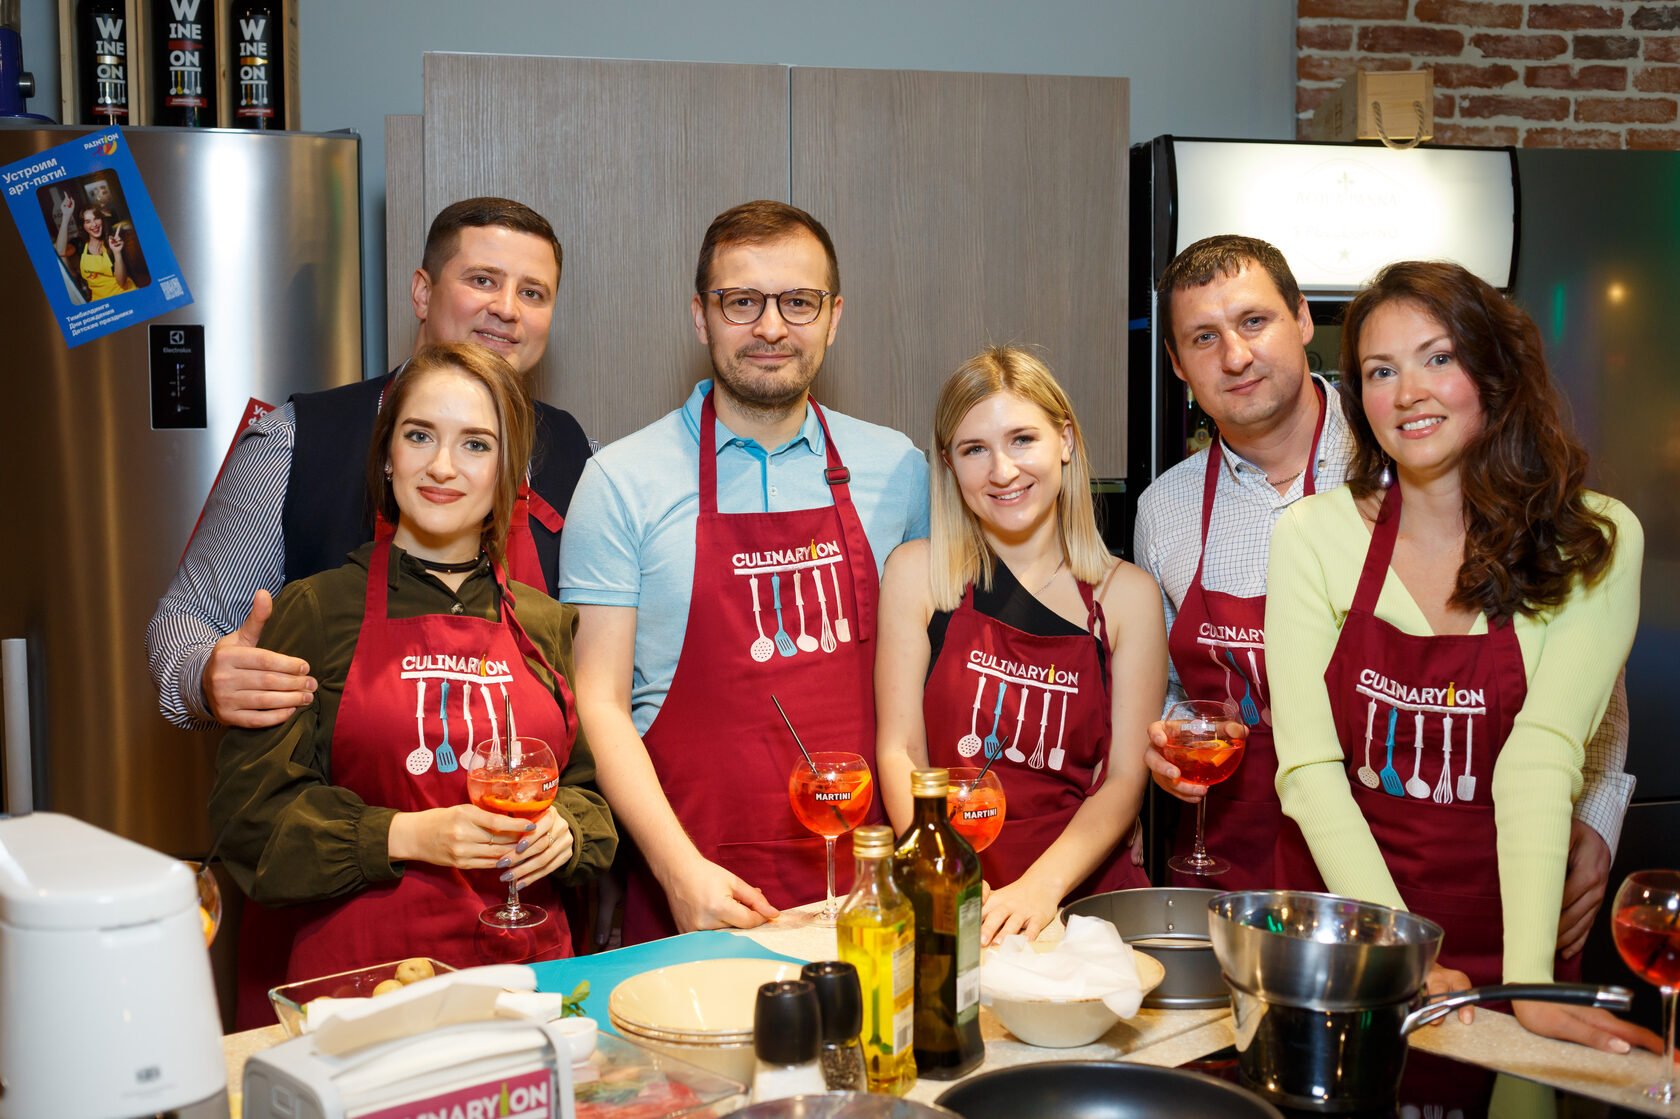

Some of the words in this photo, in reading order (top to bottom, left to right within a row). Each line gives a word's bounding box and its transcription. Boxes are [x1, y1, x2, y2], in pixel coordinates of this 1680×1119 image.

[169, 50, 200, 66] ON
[96, 64, 123, 80] ON
[240, 66, 266, 80] ON
[2, 158, 58, 184] Устроим
[8, 166, 68, 196] арт-пати!
[69, 320, 83, 331] Дни
[82, 308, 115, 326] рождения
[71, 322, 99, 337] Детские
[98, 309, 134, 326] праздники
[162, 346, 192, 354] Electrolux
[815, 792, 851, 801] MARTINI
[964, 807, 998, 820] MARTINI
